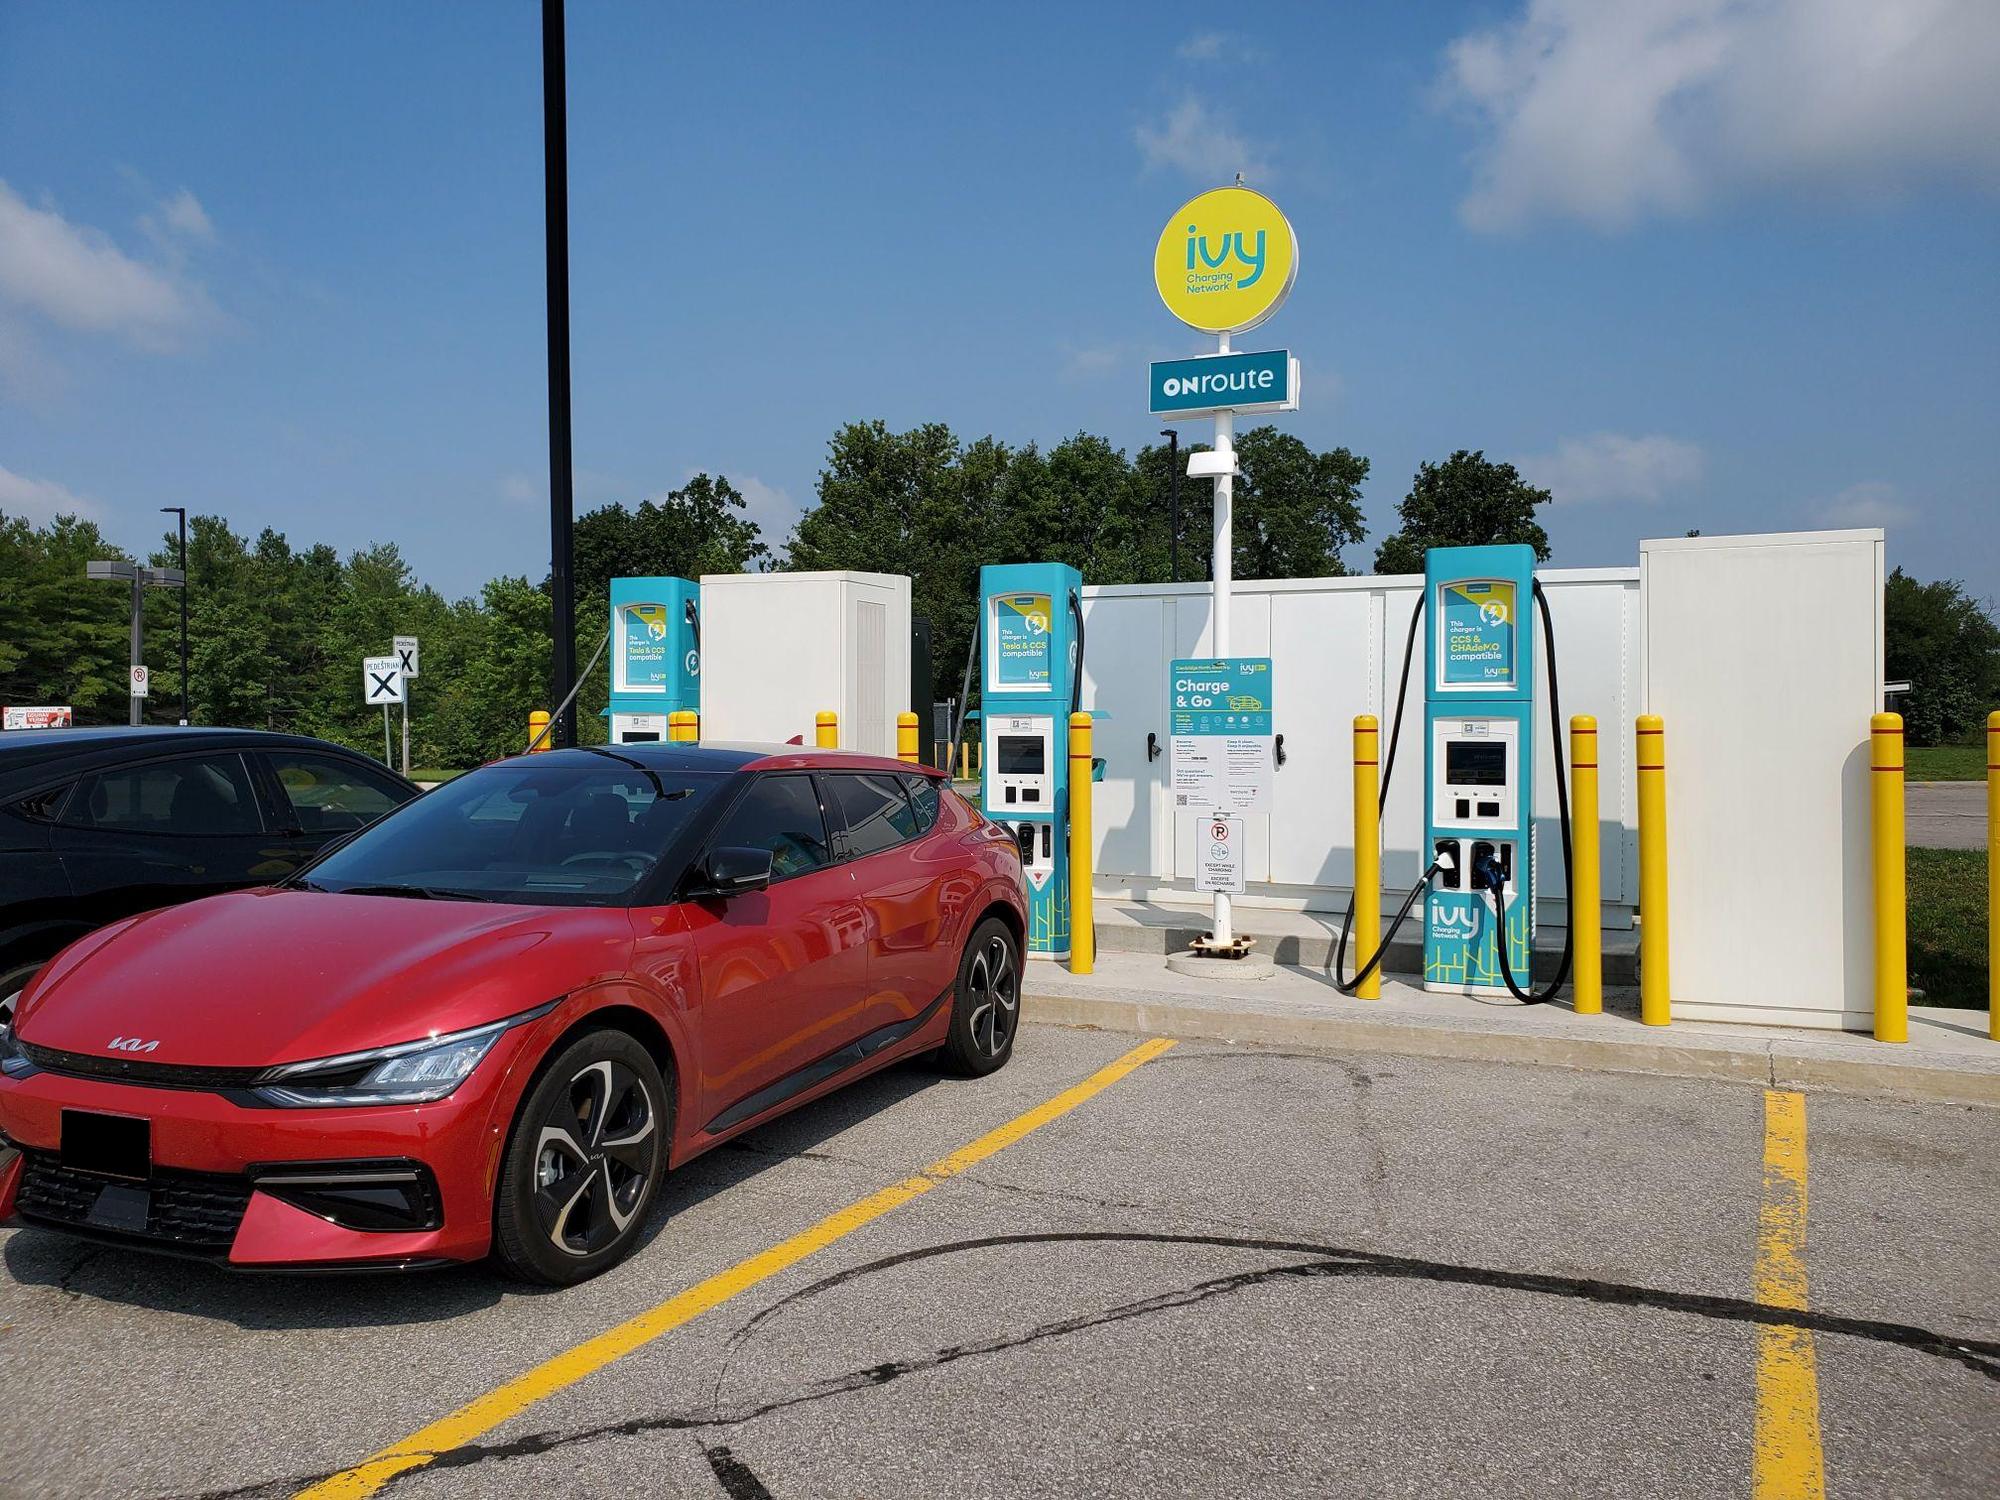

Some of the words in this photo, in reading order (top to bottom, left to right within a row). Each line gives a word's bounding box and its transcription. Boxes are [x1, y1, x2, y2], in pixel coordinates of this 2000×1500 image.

[1187, 224, 1266, 290] ivy
[1186, 272, 1233, 285] Charging
[1186, 282, 1230, 294] Network
[1163, 369, 1275, 397] ONroute
[1473, 635, 1481, 643] &
[1002, 642, 1021, 650] Tesla
[1022, 642, 1028, 650] &
[1451, 643, 1500, 651] CHAdeMO
[1002, 649, 1043, 658] compatible
[1450, 652, 1502, 662] compatible
[367, 662, 400, 670] PEDESTRIAN
[1240, 662, 1254, 675] ivy
[1484, 666, 1498, 677] ivy
[1176, 679, 1230, 695] Charge
[1176, 695, 1188, 707] &
[1190, 695, 1212, 708] Go
[1432, 898, 1479, 939] ivy
[1432, 926, 1460, 935] Charging
